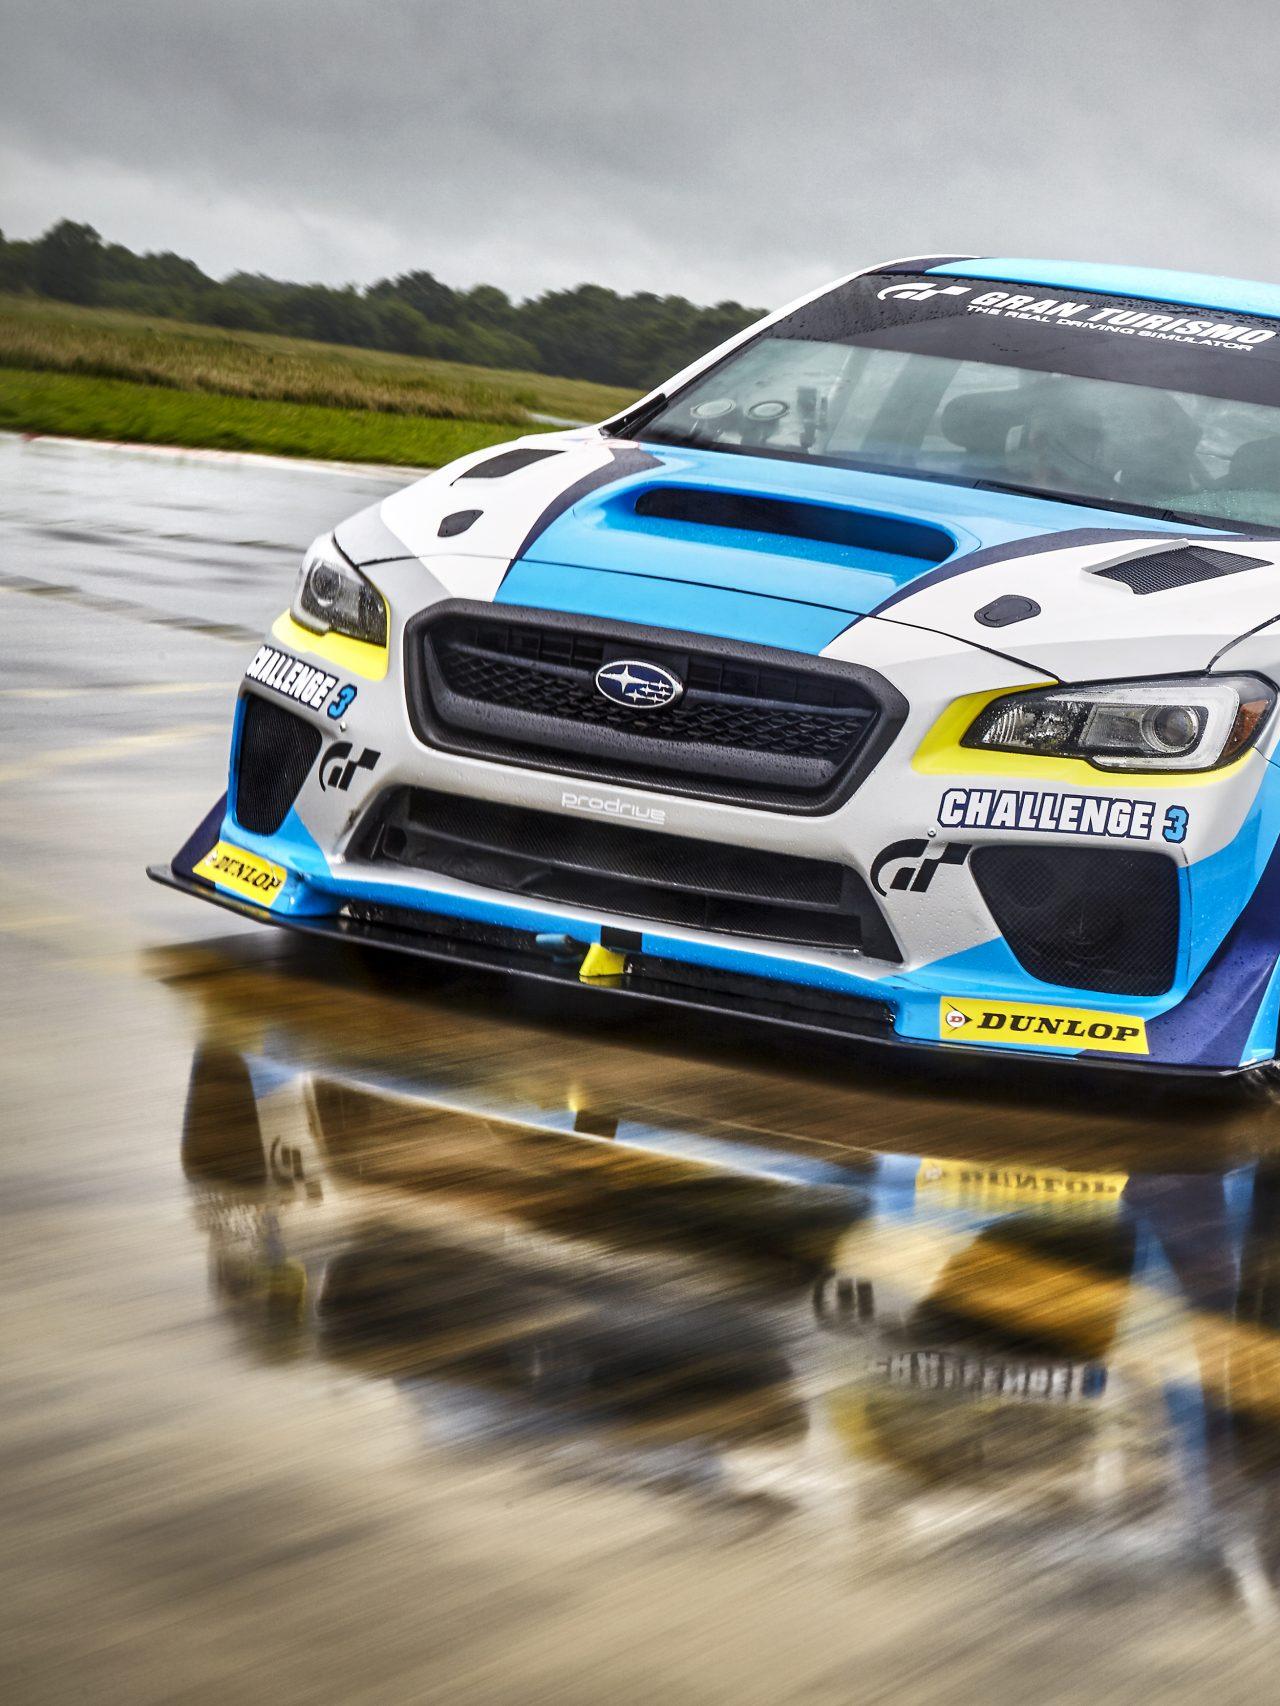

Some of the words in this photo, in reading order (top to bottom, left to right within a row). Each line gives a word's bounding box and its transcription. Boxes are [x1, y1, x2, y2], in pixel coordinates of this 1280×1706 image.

[967, 304, 1001, 316] THE
[1004, 310, 1050, 323] REAL
[1055, 318, 1136, 336] DRIVING
[1136, 329, 1254, 352] SIMULATOR
[970, 291, 1092, 318] GRAN
[1086, 307, 1277, 344] TURISMO
[327, 684, 358, 720] 3
[936, 787, 1156, 841] CHALLENGE
[1162, 804, 1190, 843] 3
[976, 1012, 1141, 1042] DUNLOP
